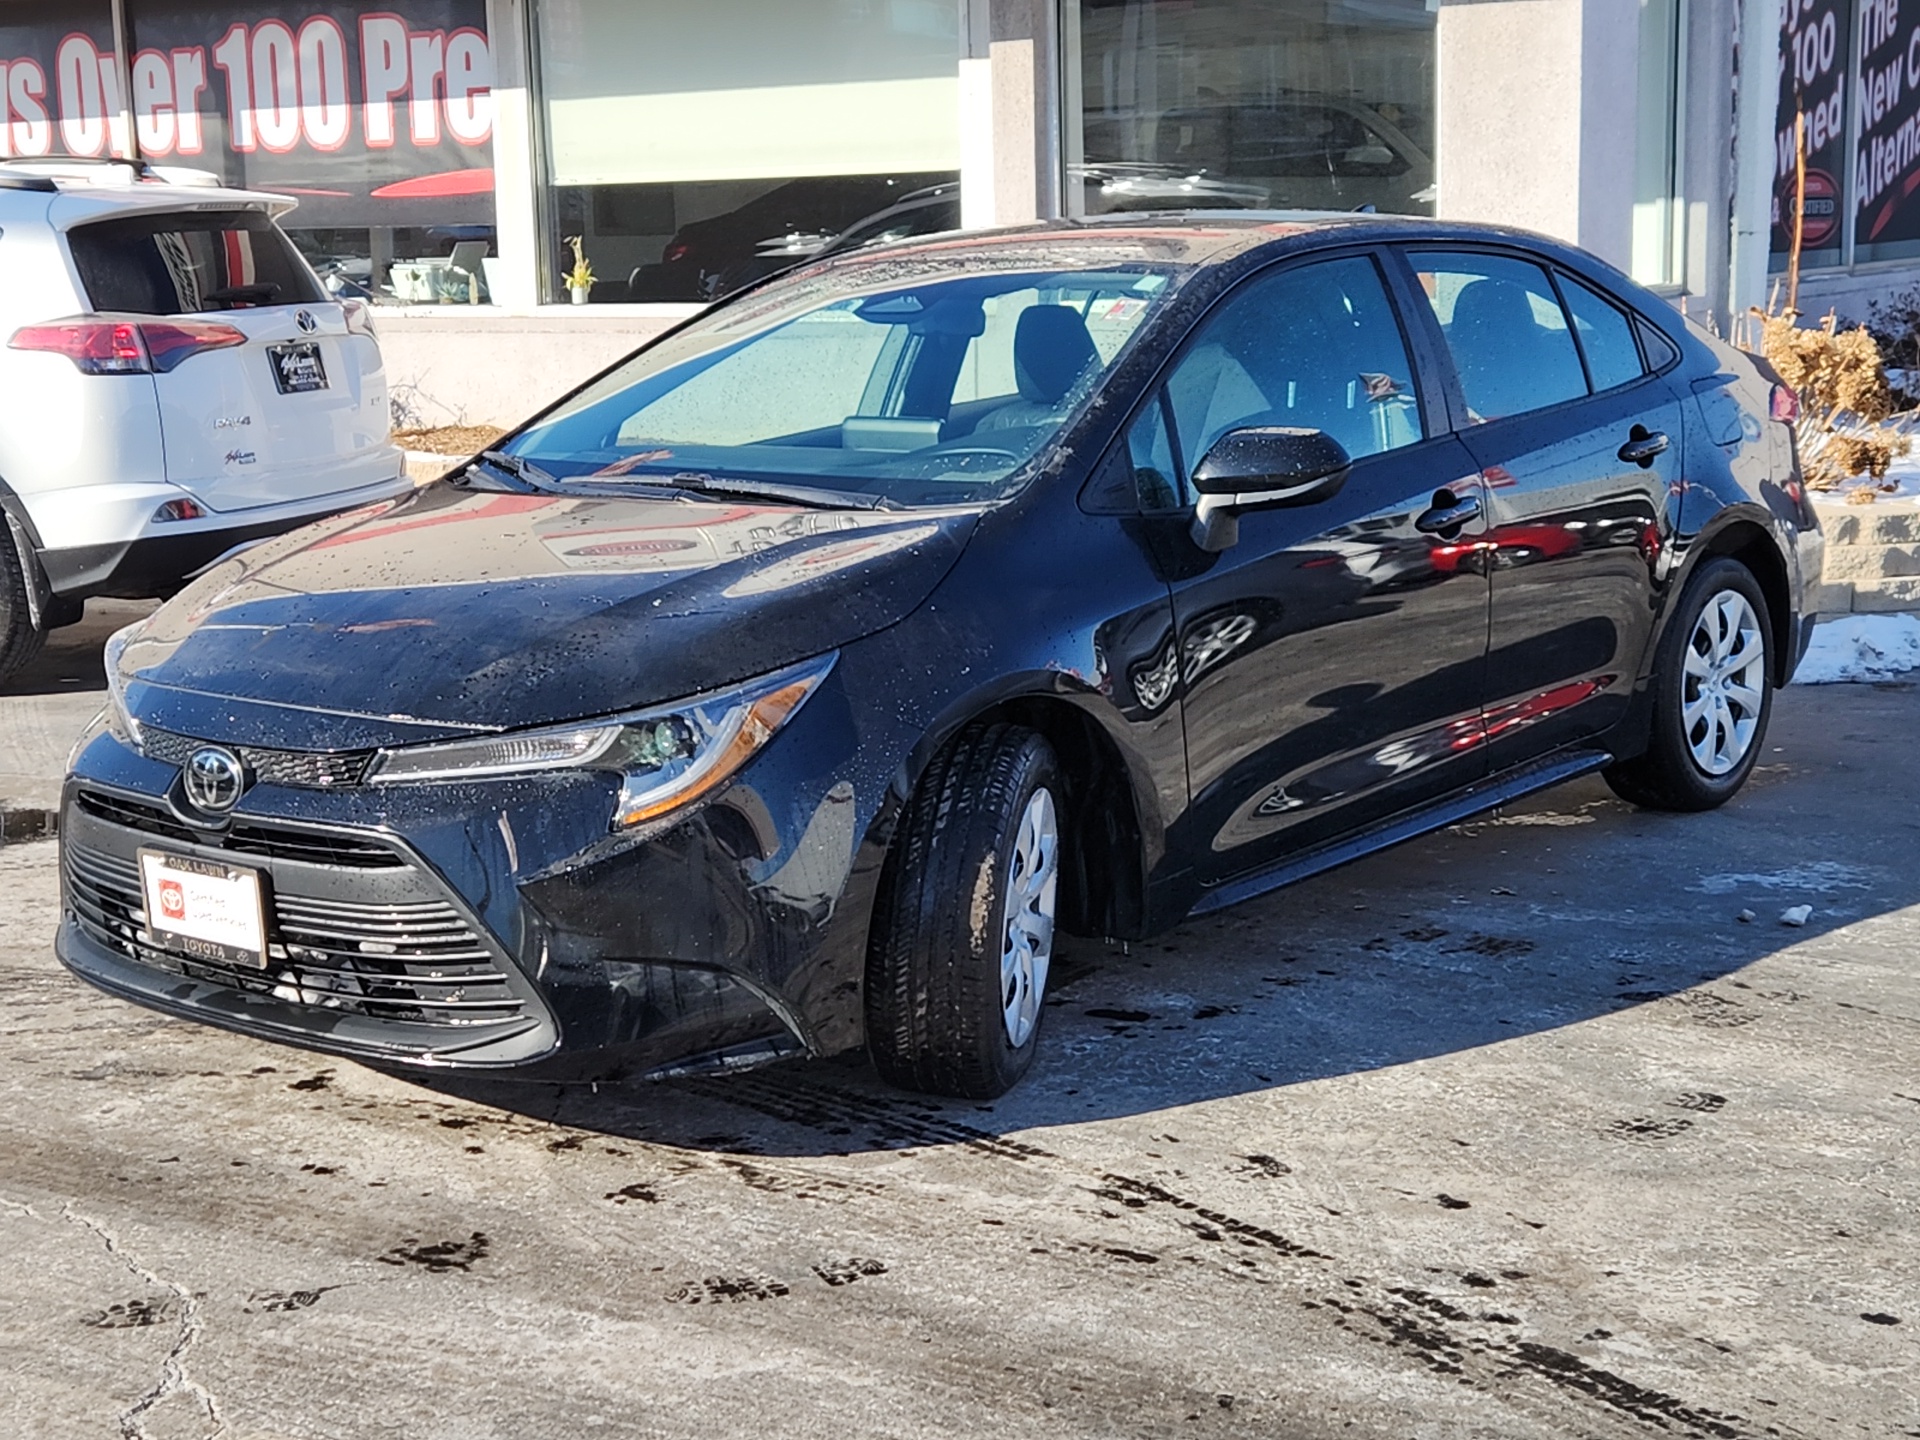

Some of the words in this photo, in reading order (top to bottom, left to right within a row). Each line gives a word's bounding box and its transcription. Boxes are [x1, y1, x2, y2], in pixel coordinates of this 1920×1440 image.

[1792, 10, 1836, 86] 100
[1860, 0, 1899, 58] The
[0, 57, 51, 157] s
[213, 15, 351, 153] 100
[358, 12, 493, 147] Pre
[1859, 54, 1903, 138] New
[1775, 72, 1843, 177] wned
[169, 857, 192, 871] OAK
[193, 861, 226, 877] LAWN
[182, 937, 225, 959] TOYOTA
